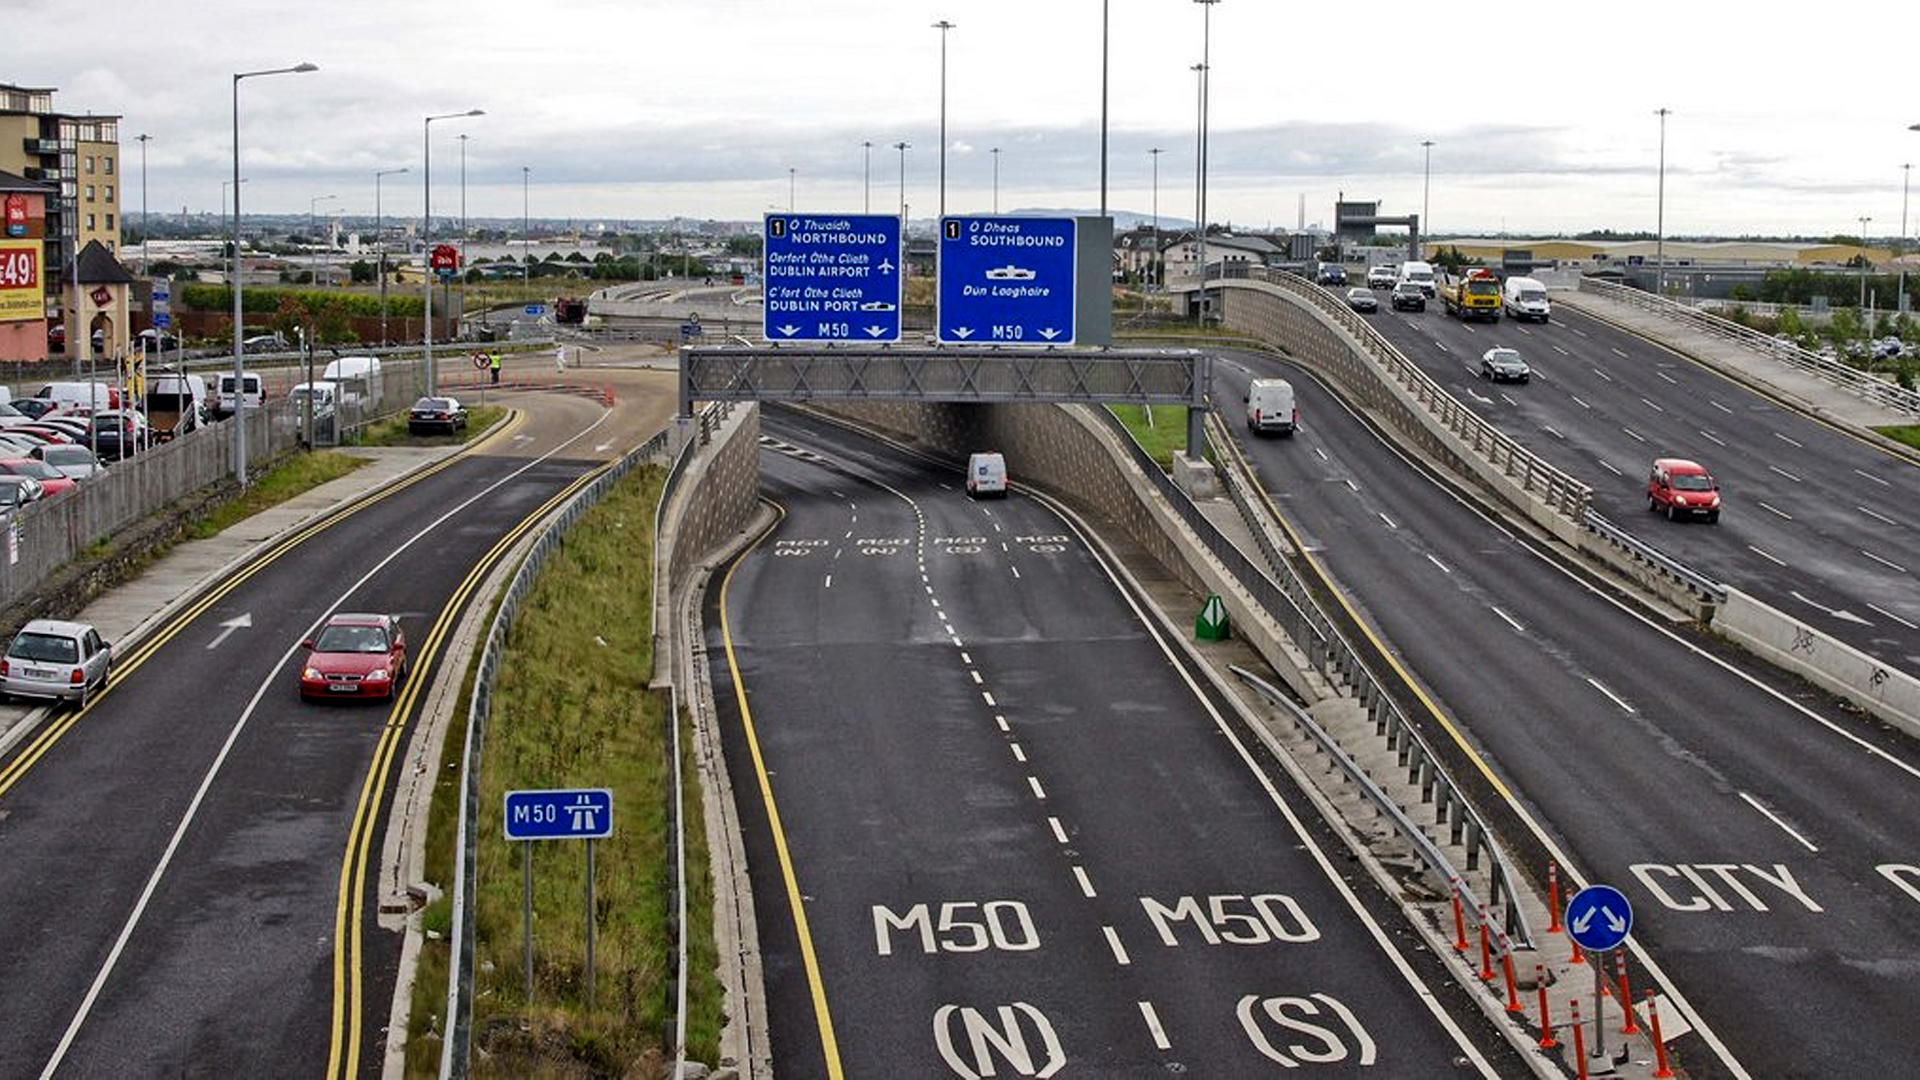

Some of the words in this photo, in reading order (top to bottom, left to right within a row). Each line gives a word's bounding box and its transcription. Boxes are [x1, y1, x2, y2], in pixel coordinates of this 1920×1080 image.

[774, 221, 781, 235] 1
[949, 223, 956, 238] 1
[791, 233, 887, 244] NORTHBOUND
[970, 234, 1065, 247] SOUTHBOUND
[770, 265, 815, 276] DUBLIN
[819, 266, 870, 277] AIRPORT
[770, 300, 819, 311] DUBLIN
[824, 300, 859, 311] PORT
[819, 323, 849, 337] M50
[992, 325, 1023, 339] M50
[514, 803, 557, 824] M50
[1628, 863, 1825, 912] CITY
[1140, 894, 1320, 946] M50
[872, 901, 1040, 955] M50
[1236, 993, 1377, 1068] (S)
[933, 1001, 1067, 1080] (N)
